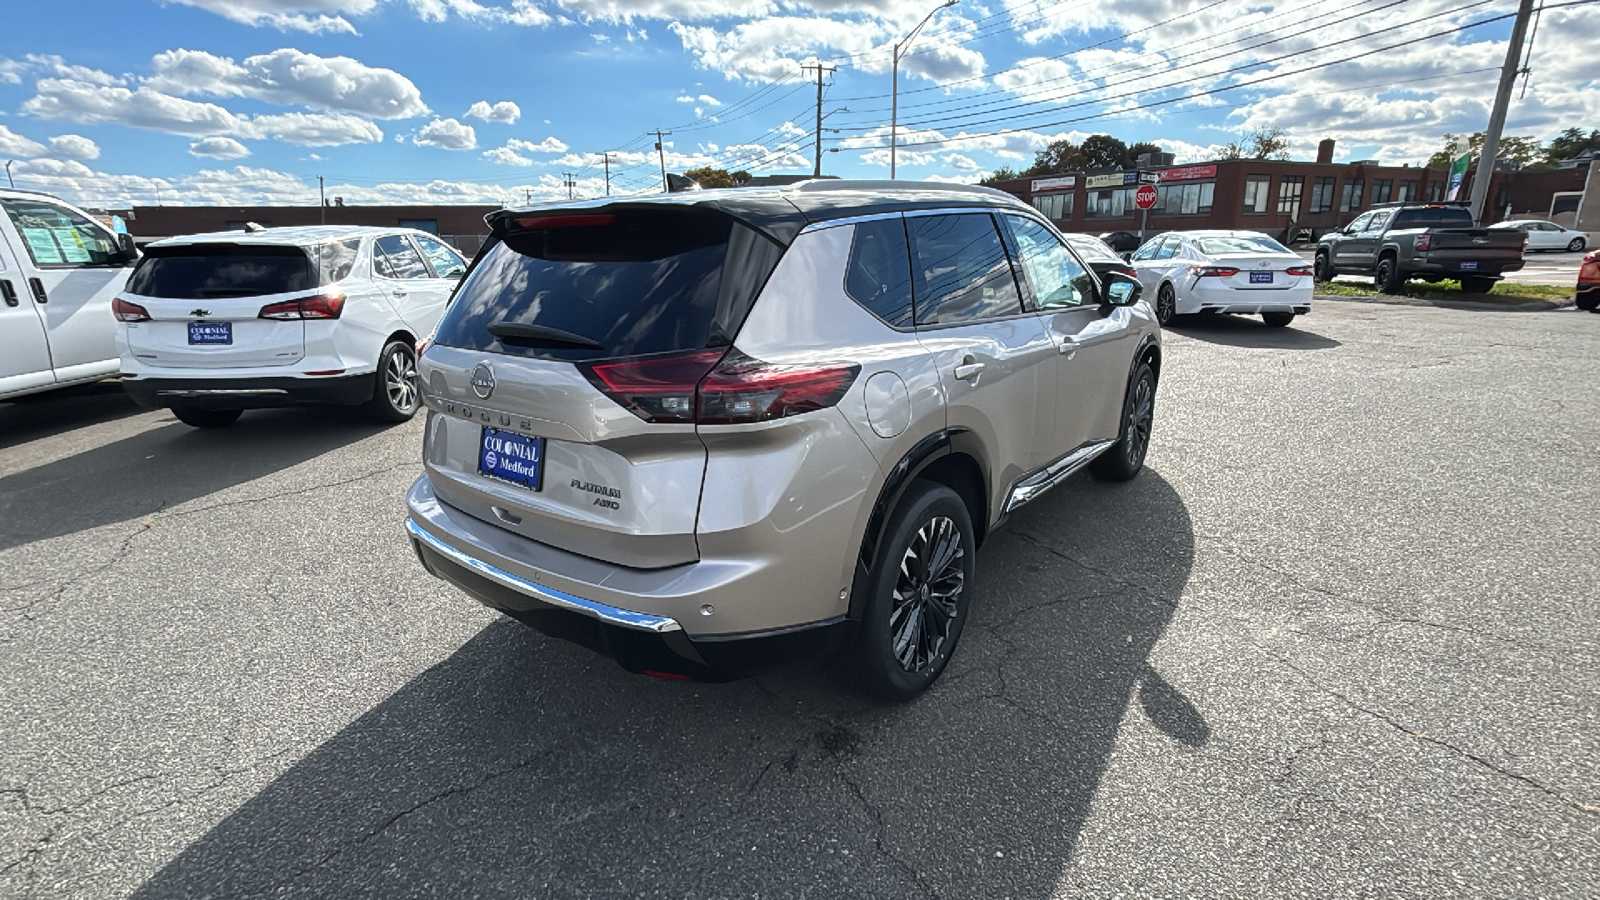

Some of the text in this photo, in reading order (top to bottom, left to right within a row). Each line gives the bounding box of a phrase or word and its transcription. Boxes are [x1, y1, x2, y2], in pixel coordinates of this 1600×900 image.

[1137, 192, 1155, 202] STOP
[447, 404, 532, 430] ROGUE
[484, 436, 539, 462] COLONIAL
[500, 457, 534, 477] Medford
[571, 479, 621, 498] PLATINUM
[593, 498, 620, 510] AWD
